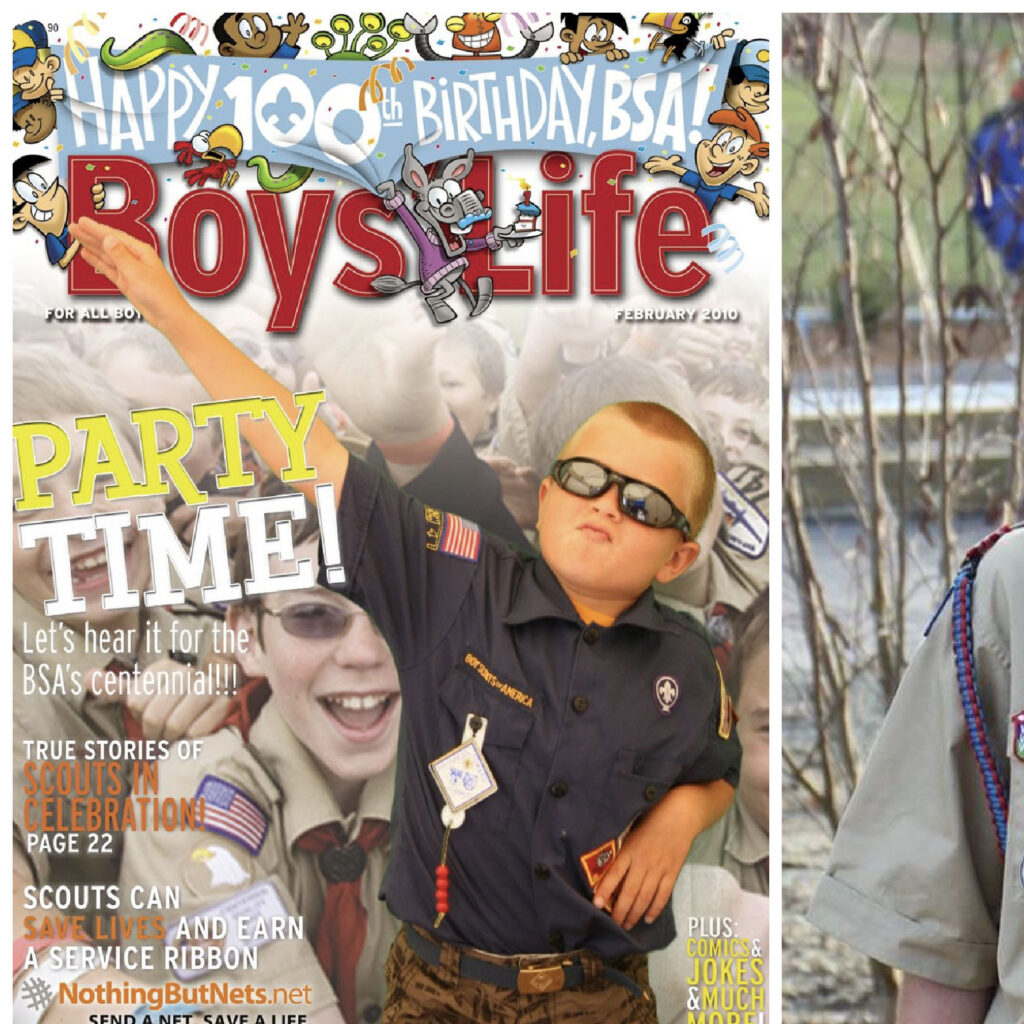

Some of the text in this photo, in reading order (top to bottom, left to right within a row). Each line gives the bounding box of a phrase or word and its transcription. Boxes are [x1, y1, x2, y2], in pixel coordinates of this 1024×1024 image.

[47, 23, 59, 33] 90
[65, 56, 220, 152] HAPPY
[224, 73, 402, 165] 100th
[604, 64, 719, 154] BSA!
[67, 155, 409, 333] Boys
[44, 307, 75, 320] FOR
[80, 307, 109, 320] ALL
[614, 308, 738, 320] FEBRUARY 2010
[12, 389, 326, 512] PARTY
[18, 483, 346, 616] TIME!
[23, 622, 250, 655] Let's hear it for the
[23, 663, 239, 696] BSA's centennial!!!
[22, 740, 205, 760] TRUE STORIES OF
[23, 761, 160, 796] SCOUTS IN
[23, 797, 207, 832] CELEBRATION!
[27, 833, 113, 853] PAGE 22
[23, 885, 181, 909] SCOUTS CAN
[23, 916, 304, 940] SAVE LIVES AND EARN
[688, 917, 739, 938] PLUS:
[23, 946, 259, 970] A SERVICE RIBBON
[686, 958, 764, 986] JOKES
[59, 982, 312, 1010] NothingButNets.net
